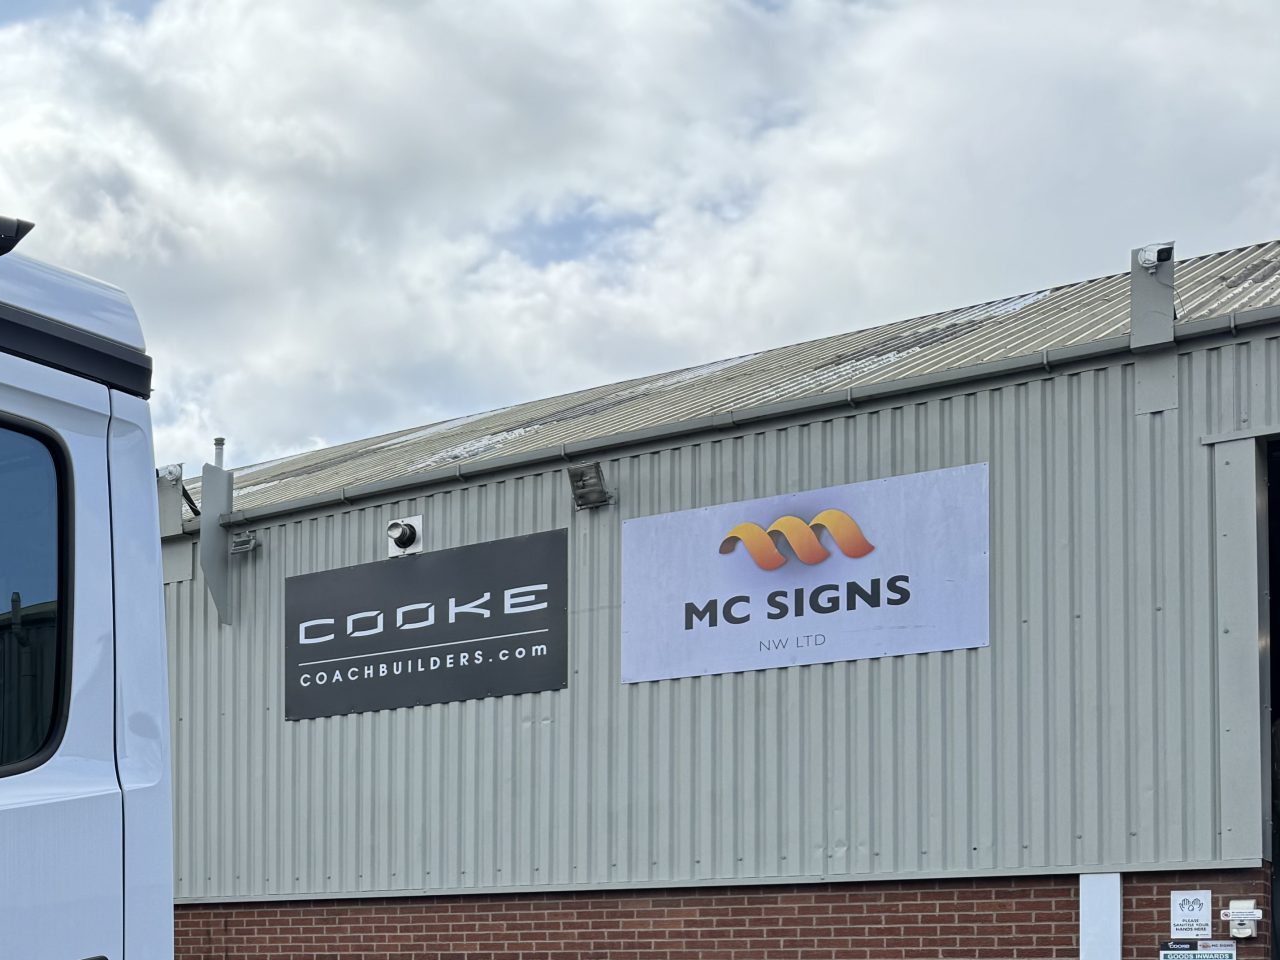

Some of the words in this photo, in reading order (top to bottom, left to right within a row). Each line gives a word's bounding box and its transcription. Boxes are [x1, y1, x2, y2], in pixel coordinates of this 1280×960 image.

[298, 583, 549, 645] COOKE
[683, 595, 752, 631] MC
[766, 575, 912, 621] SIGNS
[299, 643, 548, 687] COACHBUILDERS.com
[758, 637, 789, 653] NW
[796, 634, 827, 649] LTD
